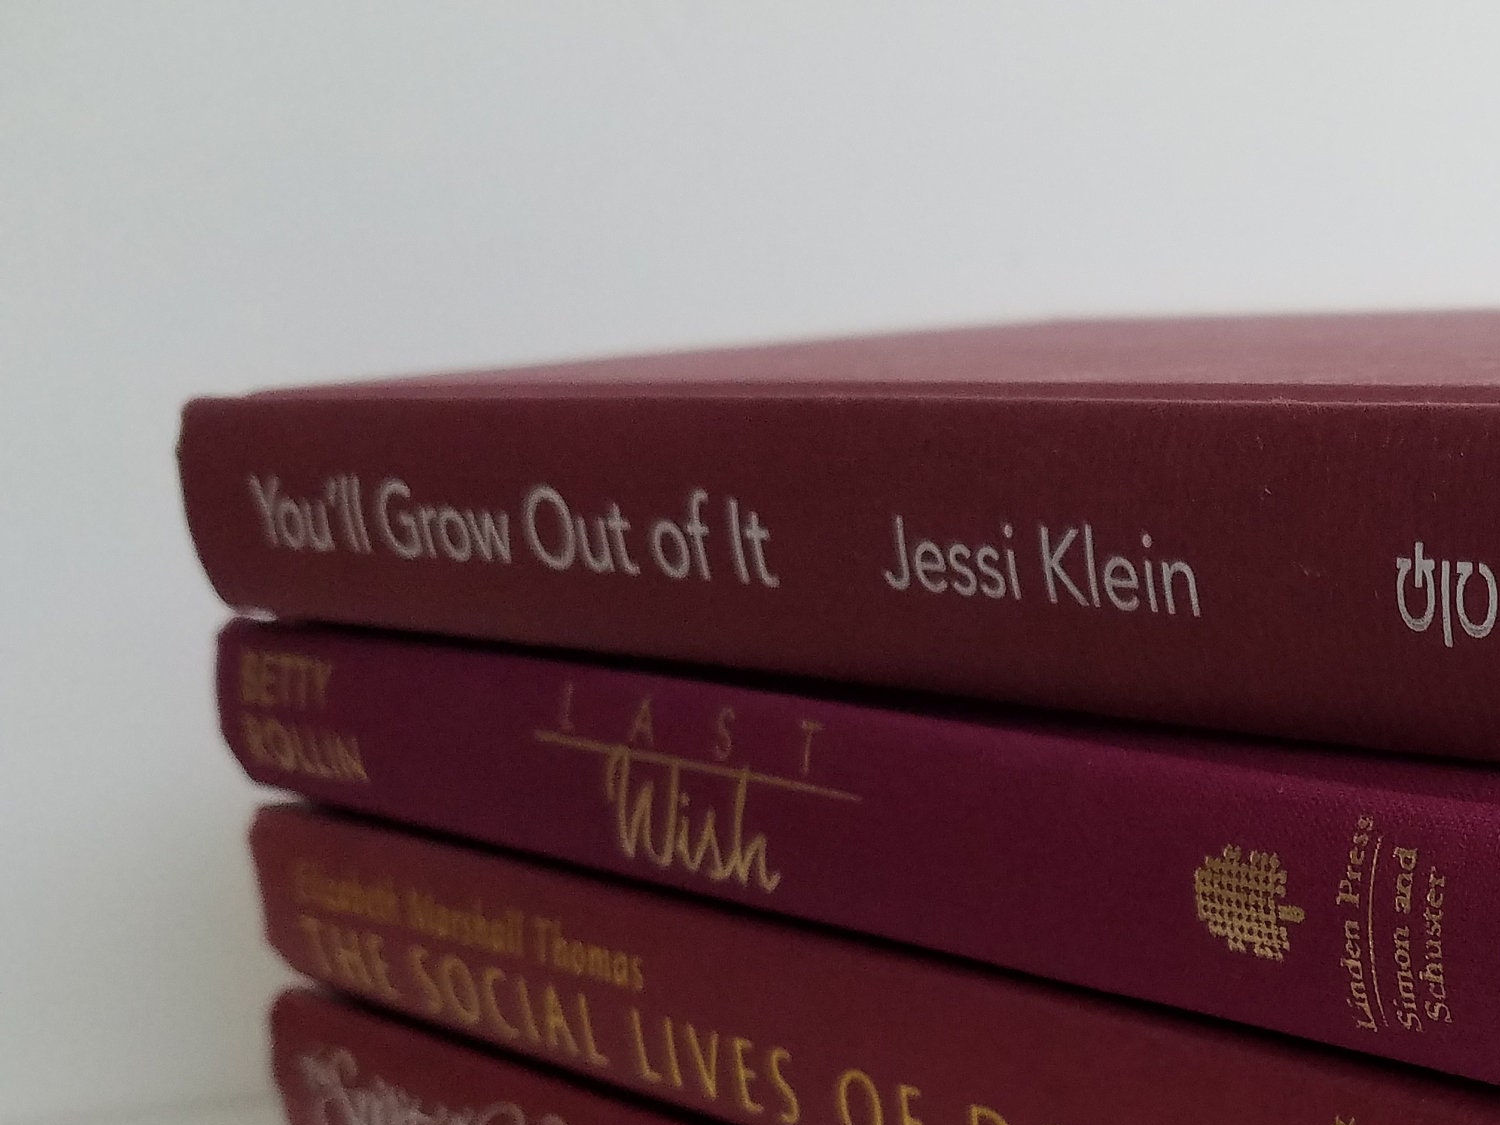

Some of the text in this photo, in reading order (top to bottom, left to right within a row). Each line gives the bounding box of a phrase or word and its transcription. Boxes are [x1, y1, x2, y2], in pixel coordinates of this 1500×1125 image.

[250, 474, 781, 590] You'll Grow Out of It
[883, 514, 1202, 619] Jessi Klein
[240, 647, 335, 709] BETTY
[606, 745, 781, 894] Wish
[531, 915, 645, 992] Thomas
[1336, 813, 1378, 1033] Linden Press
[1392, 846, 1423, 1033] Simon and
[1418, 865, 1453, 1024] Schuster
[298, 914, 404, 1003] THE
[405, 944, 610, 1069] SOCIAL
[630, 1006, 800, 1125] LIVES
